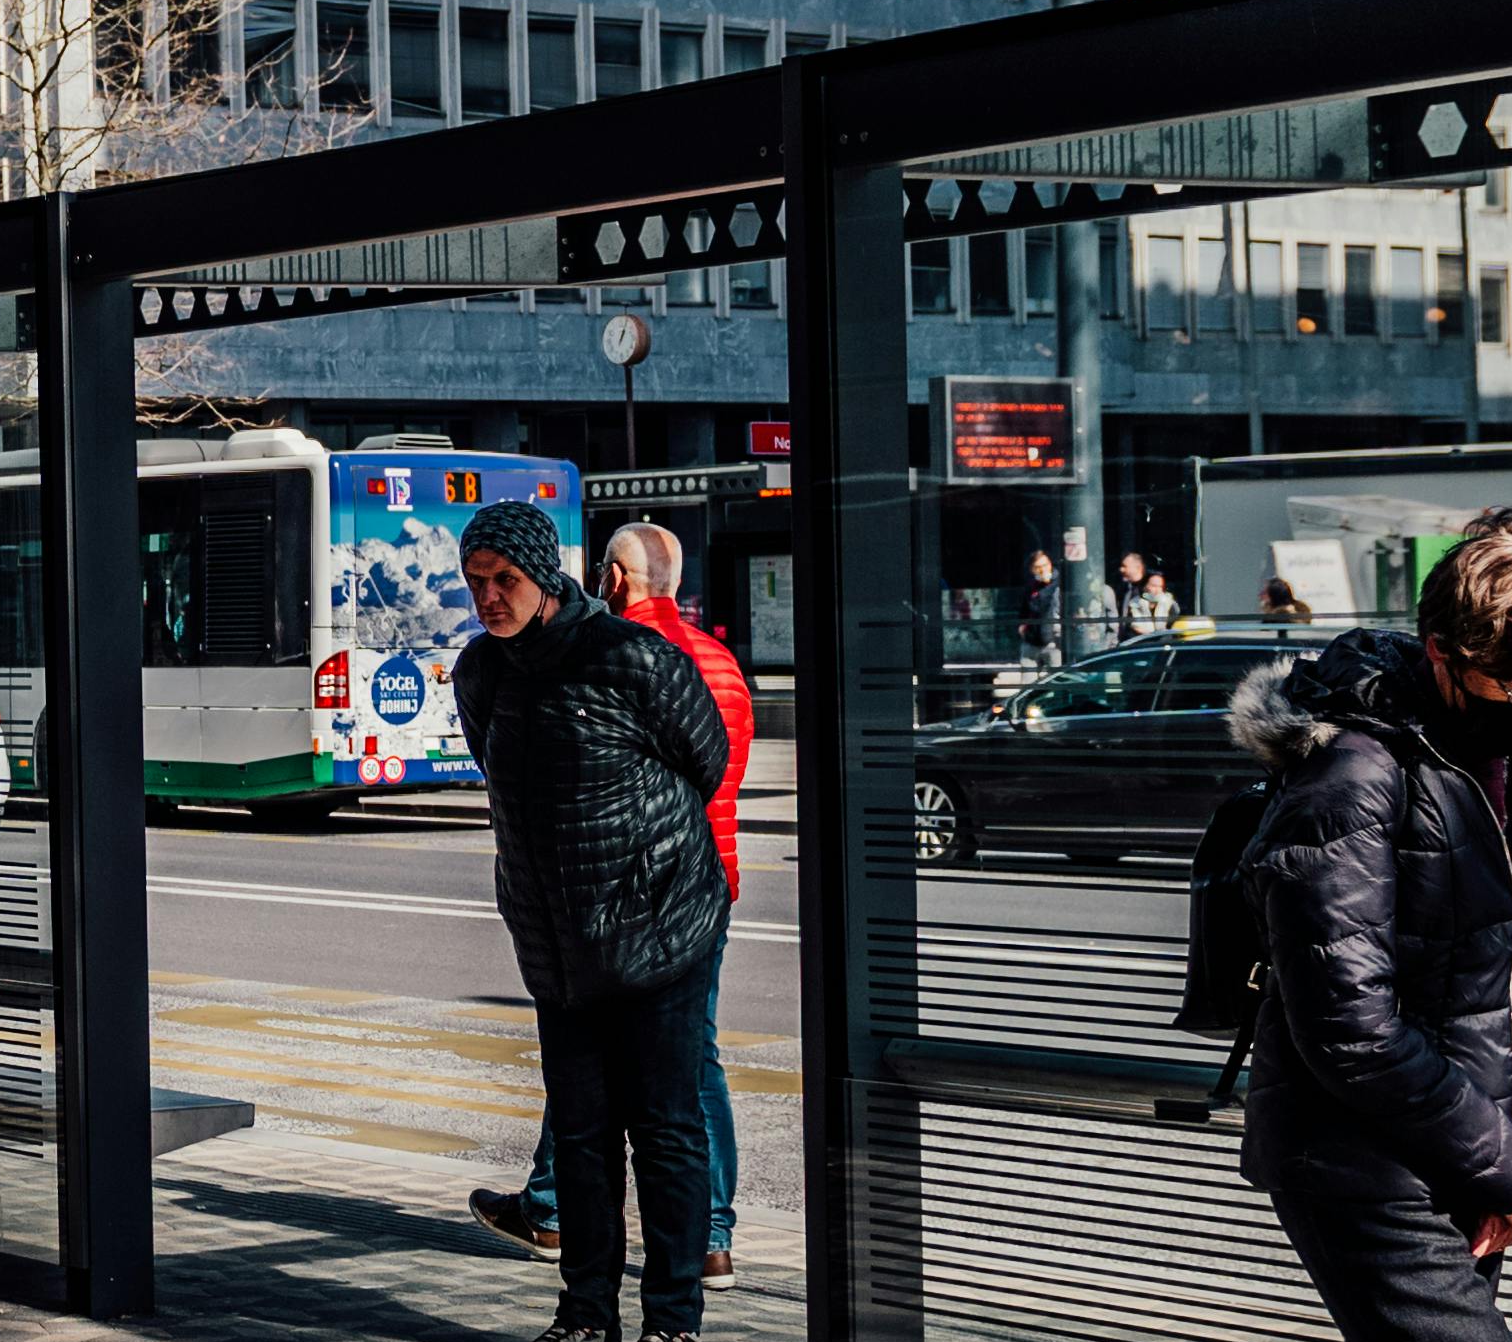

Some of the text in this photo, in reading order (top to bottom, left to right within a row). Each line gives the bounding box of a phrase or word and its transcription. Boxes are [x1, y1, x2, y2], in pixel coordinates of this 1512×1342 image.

[378, 675, 418, 691] VOGEL
[379, 699, 418, 713] BOHINJ
[389, 763, 399, 774] 70
[432, 760, 481, 773] www.vo
